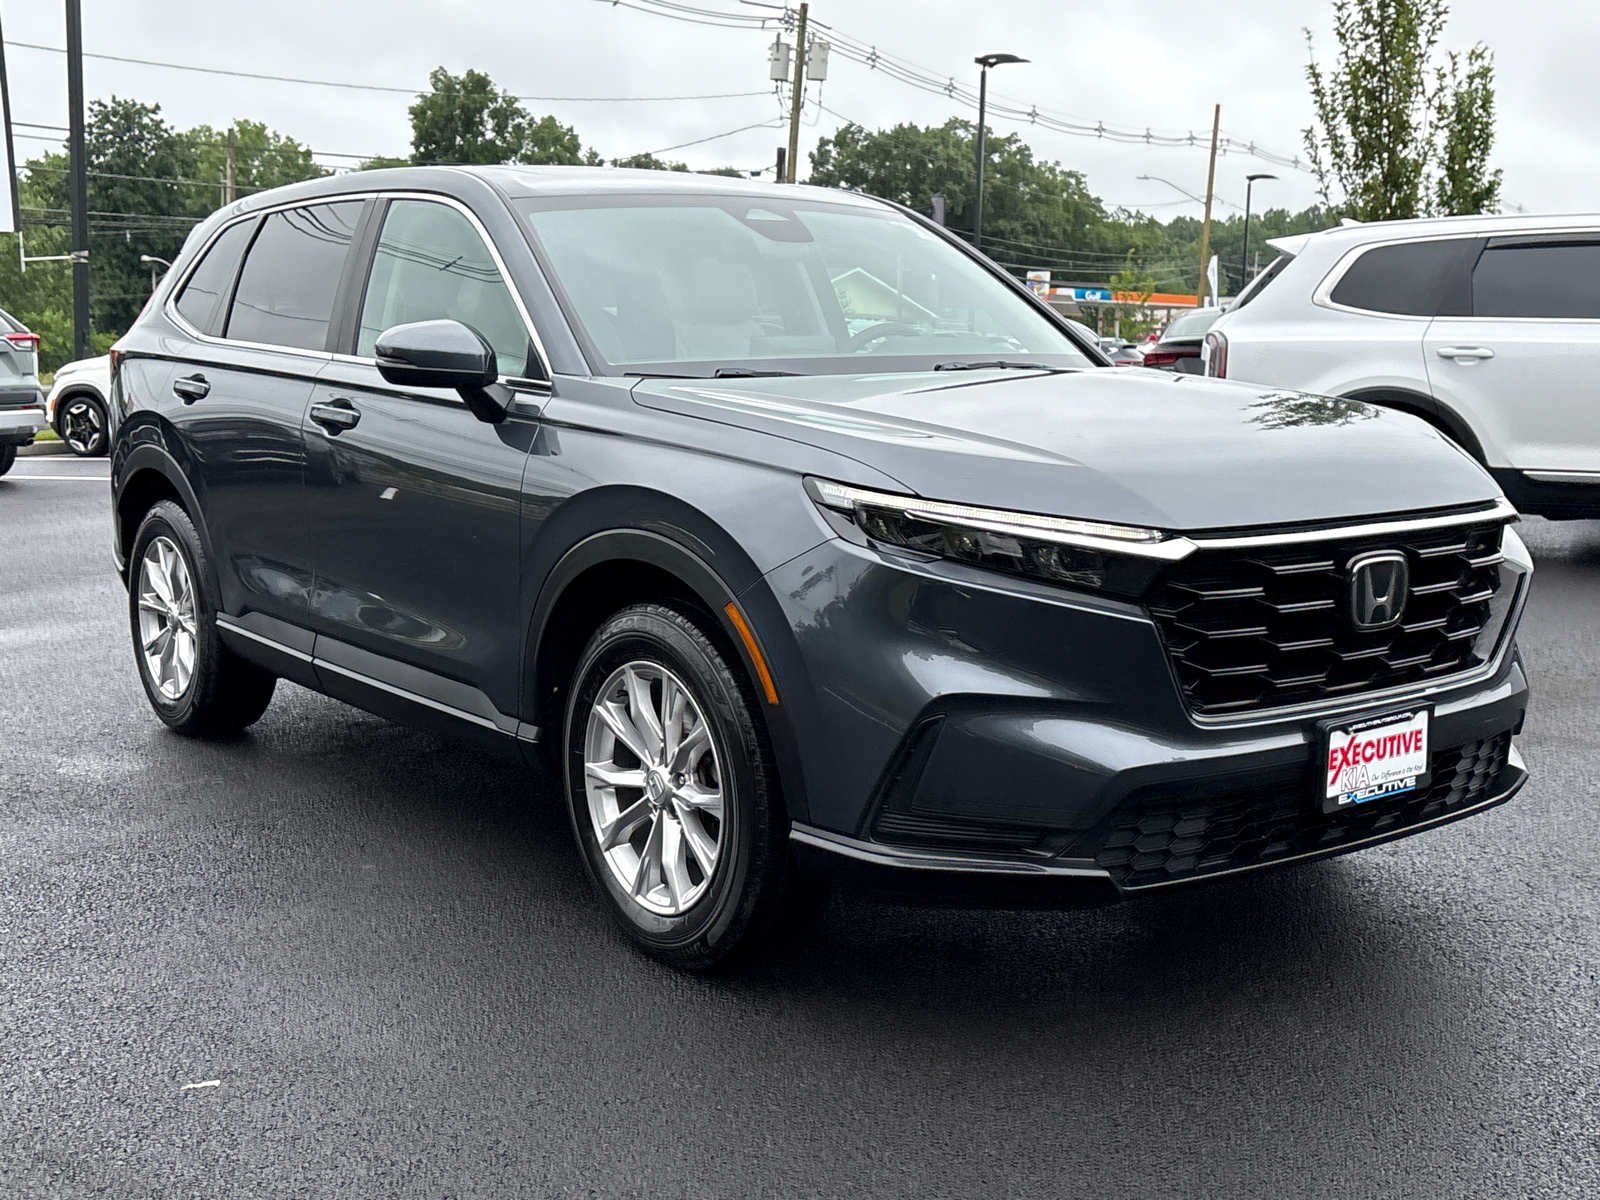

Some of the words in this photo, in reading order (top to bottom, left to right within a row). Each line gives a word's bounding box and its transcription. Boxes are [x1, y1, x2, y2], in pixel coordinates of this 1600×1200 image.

[1328, 728, 1423, 786] EXECUTIVE
[1338, 776, 1416, 805] EXECUTIVE
[1341, 764, 1371, 792] KIA
